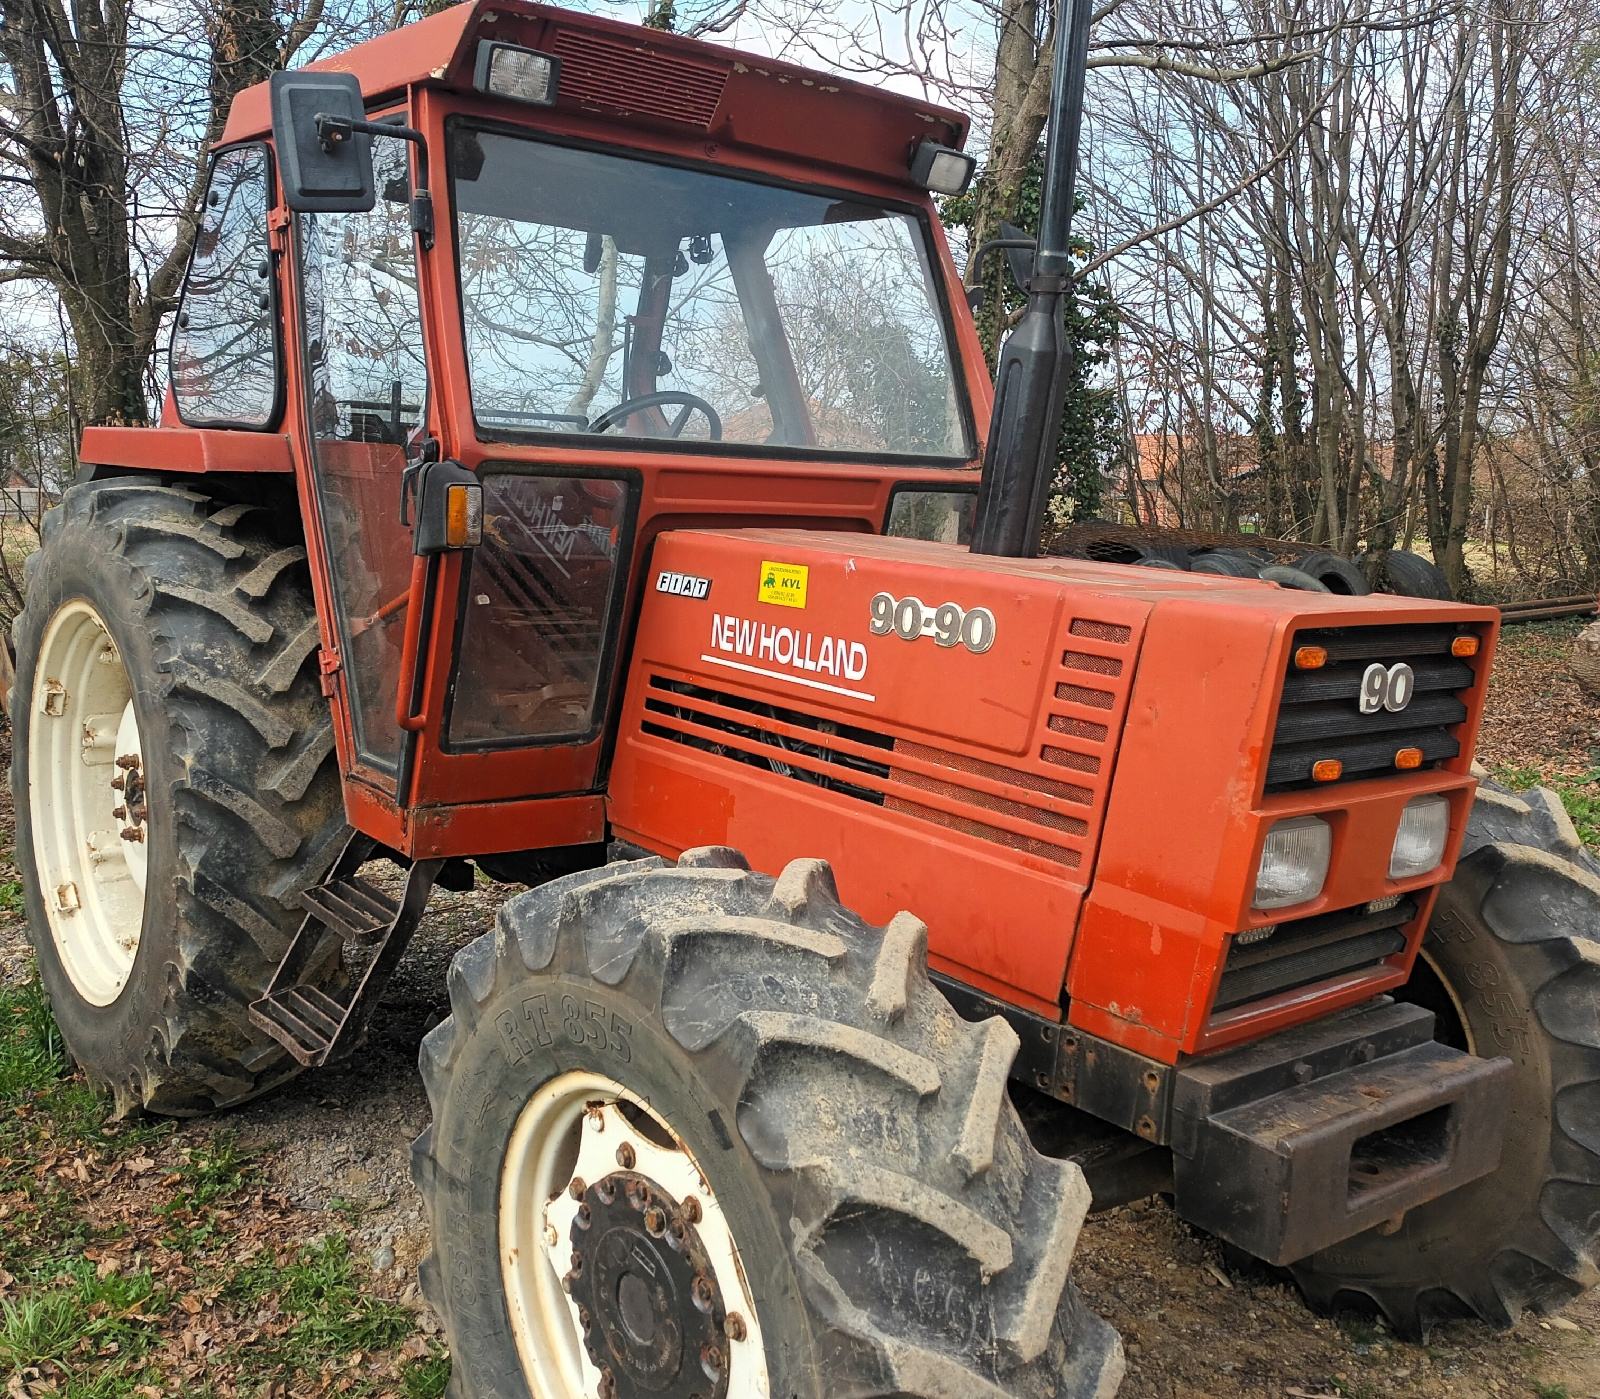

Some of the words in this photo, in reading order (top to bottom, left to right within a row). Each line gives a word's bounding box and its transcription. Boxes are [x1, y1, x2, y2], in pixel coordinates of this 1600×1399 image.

[657, 572, 710, 599] FIAT
[781, 577, 801, 590] KVL
[711, 613, 758, 656] NEW
[758, 623, 868, 681] HOLLAND
[869, 591, 996, 653] 90-90
[1359, 662, 1414, 714] 90
[494, 993, 553, 1067] RT
[561, 994, 632, 1064] 855
